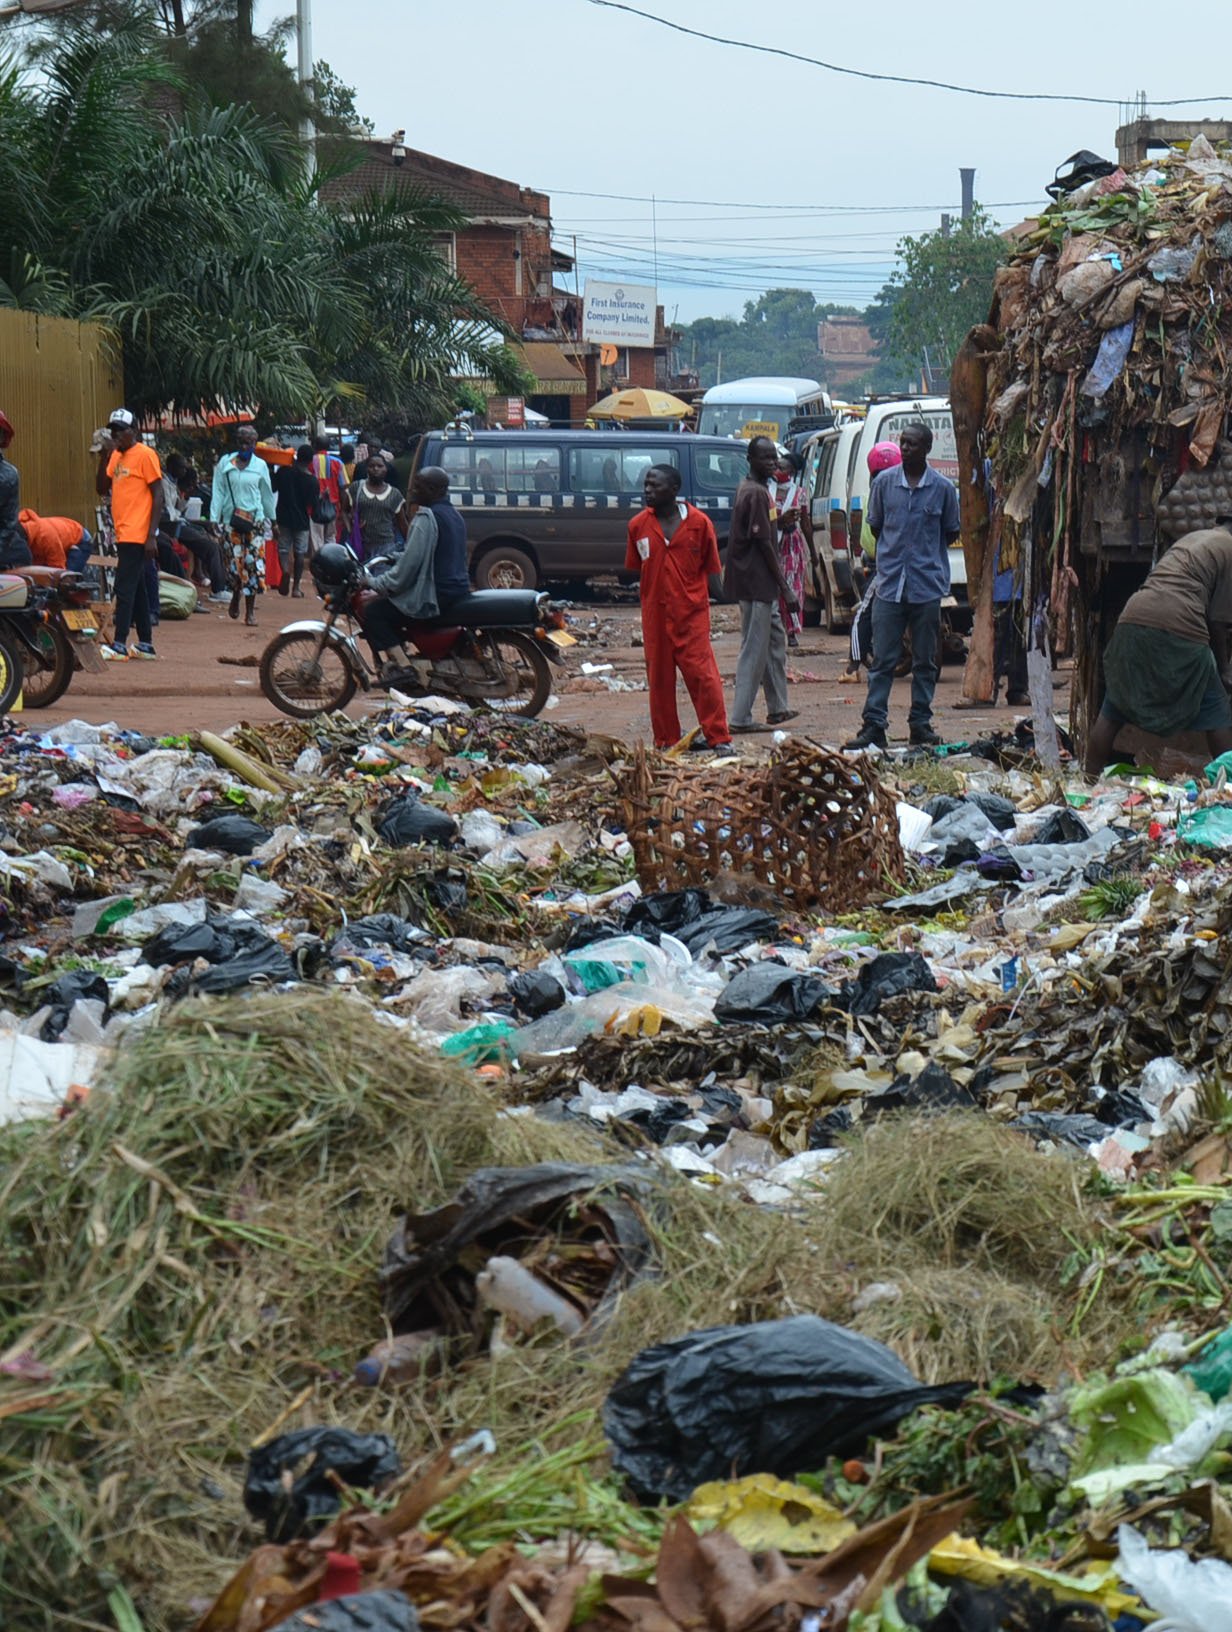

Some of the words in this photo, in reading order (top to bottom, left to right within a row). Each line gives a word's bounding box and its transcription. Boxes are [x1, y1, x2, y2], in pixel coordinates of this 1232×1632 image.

[591, 297, 608, 308] First
[609, 299, 645, 310] Insurance
[587, 311, 620, 323] Company
[621, 312, 650, 325] Limited.
